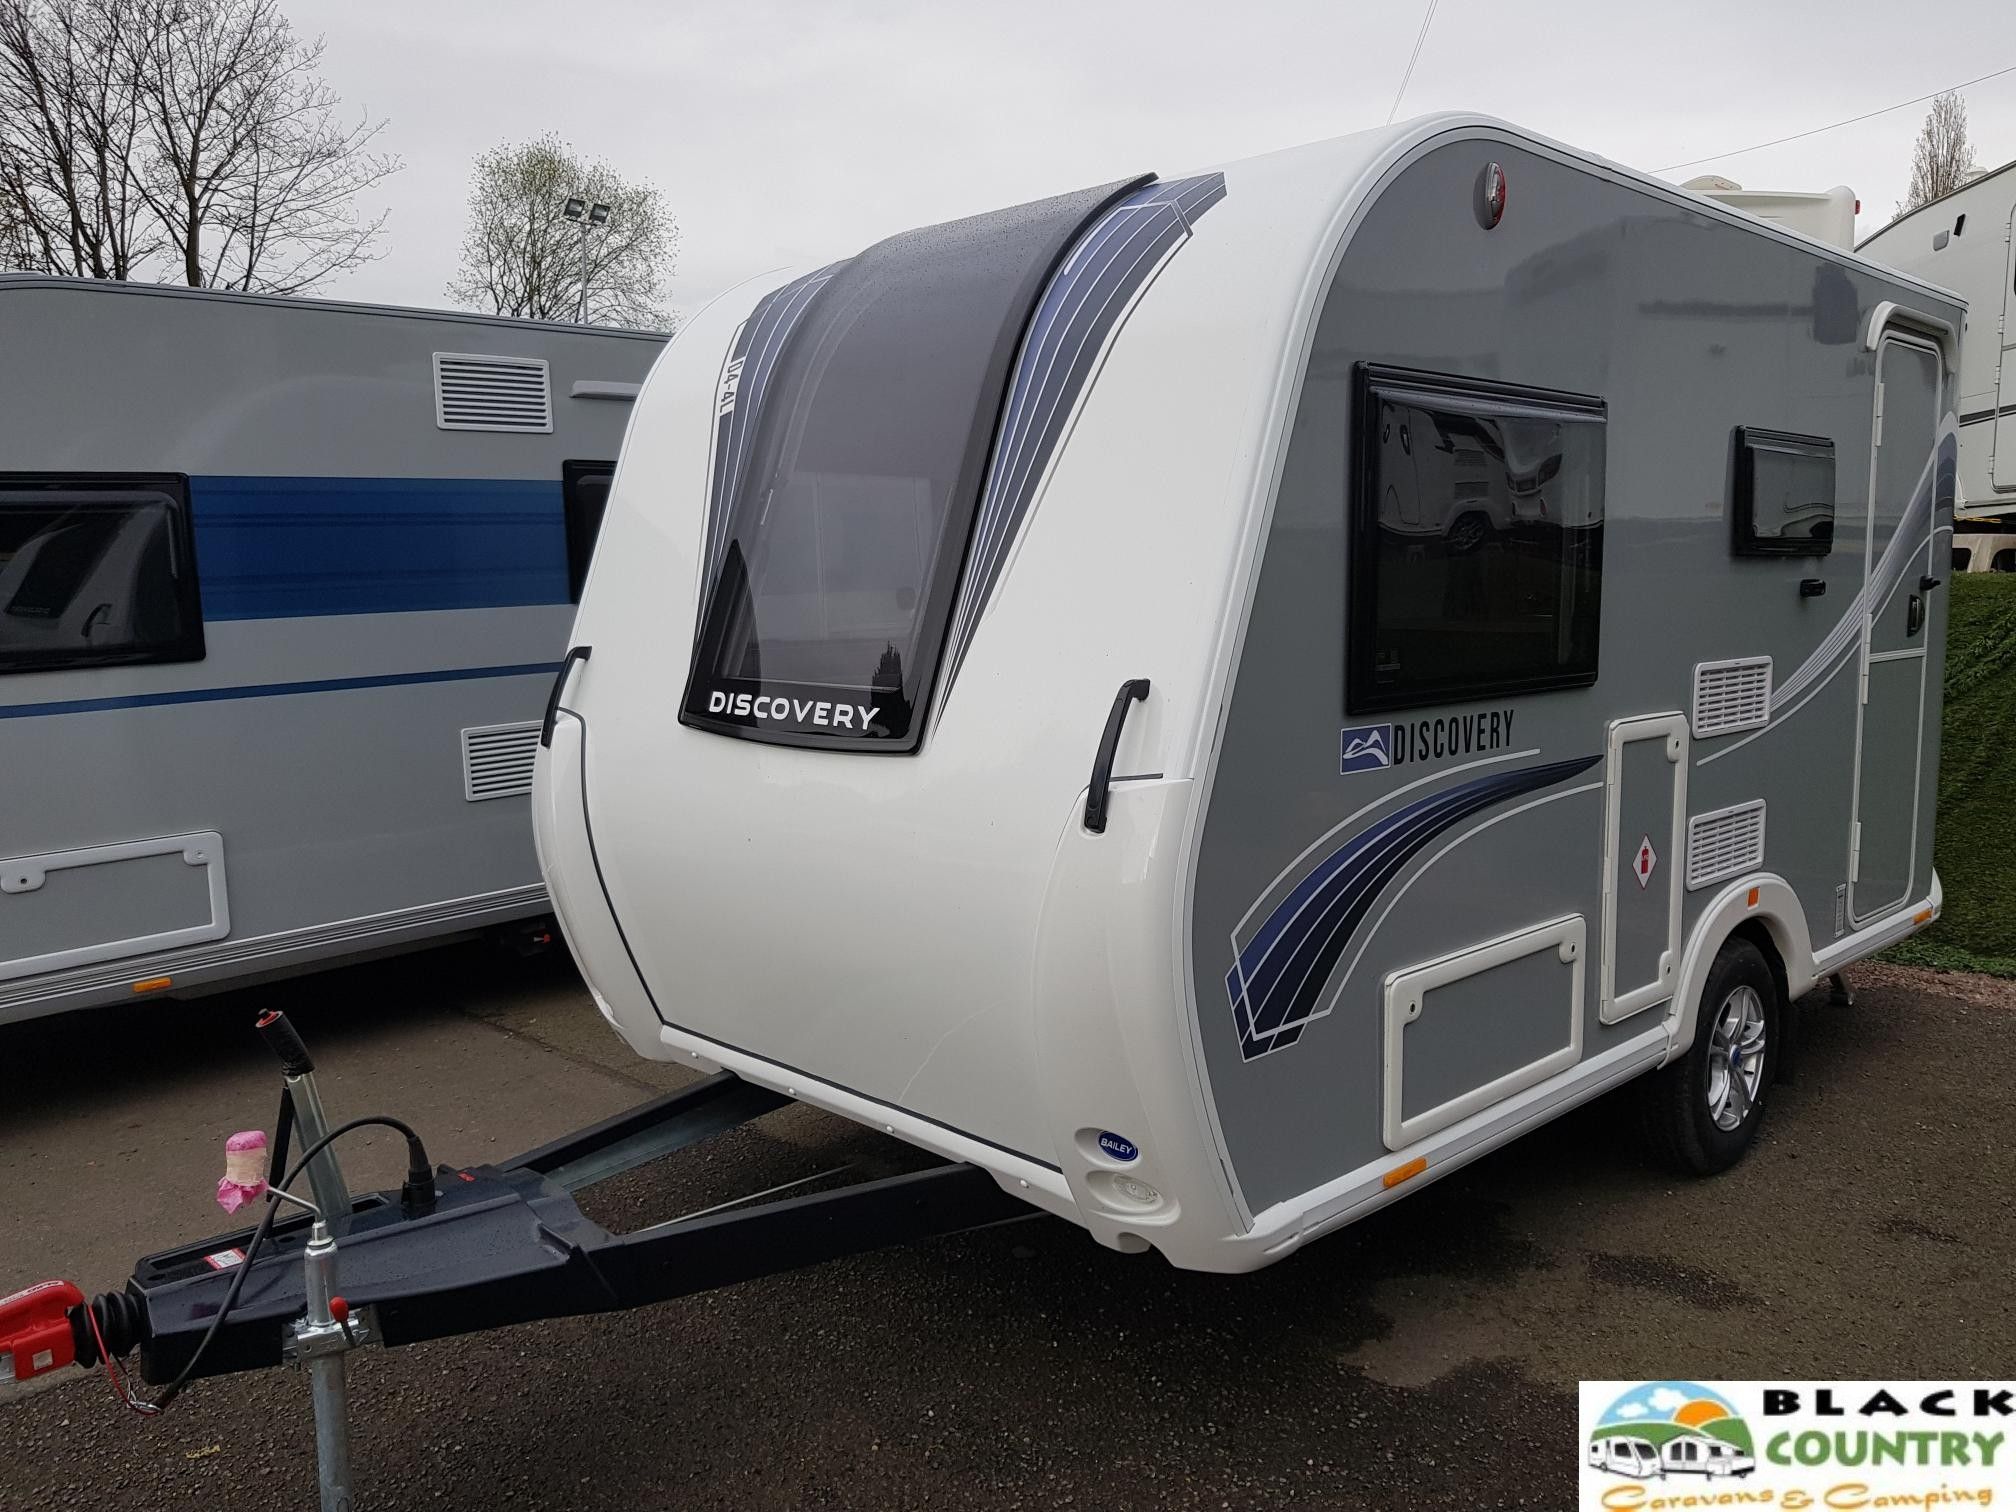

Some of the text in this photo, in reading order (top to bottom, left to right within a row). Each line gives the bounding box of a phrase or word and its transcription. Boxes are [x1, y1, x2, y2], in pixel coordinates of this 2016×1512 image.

[708, 690, 881, 731] DISCOVERY
[1393, 709, 1515, 766] DISCOVERY
[1100, 1137, 1133, 1155] BAILEY
